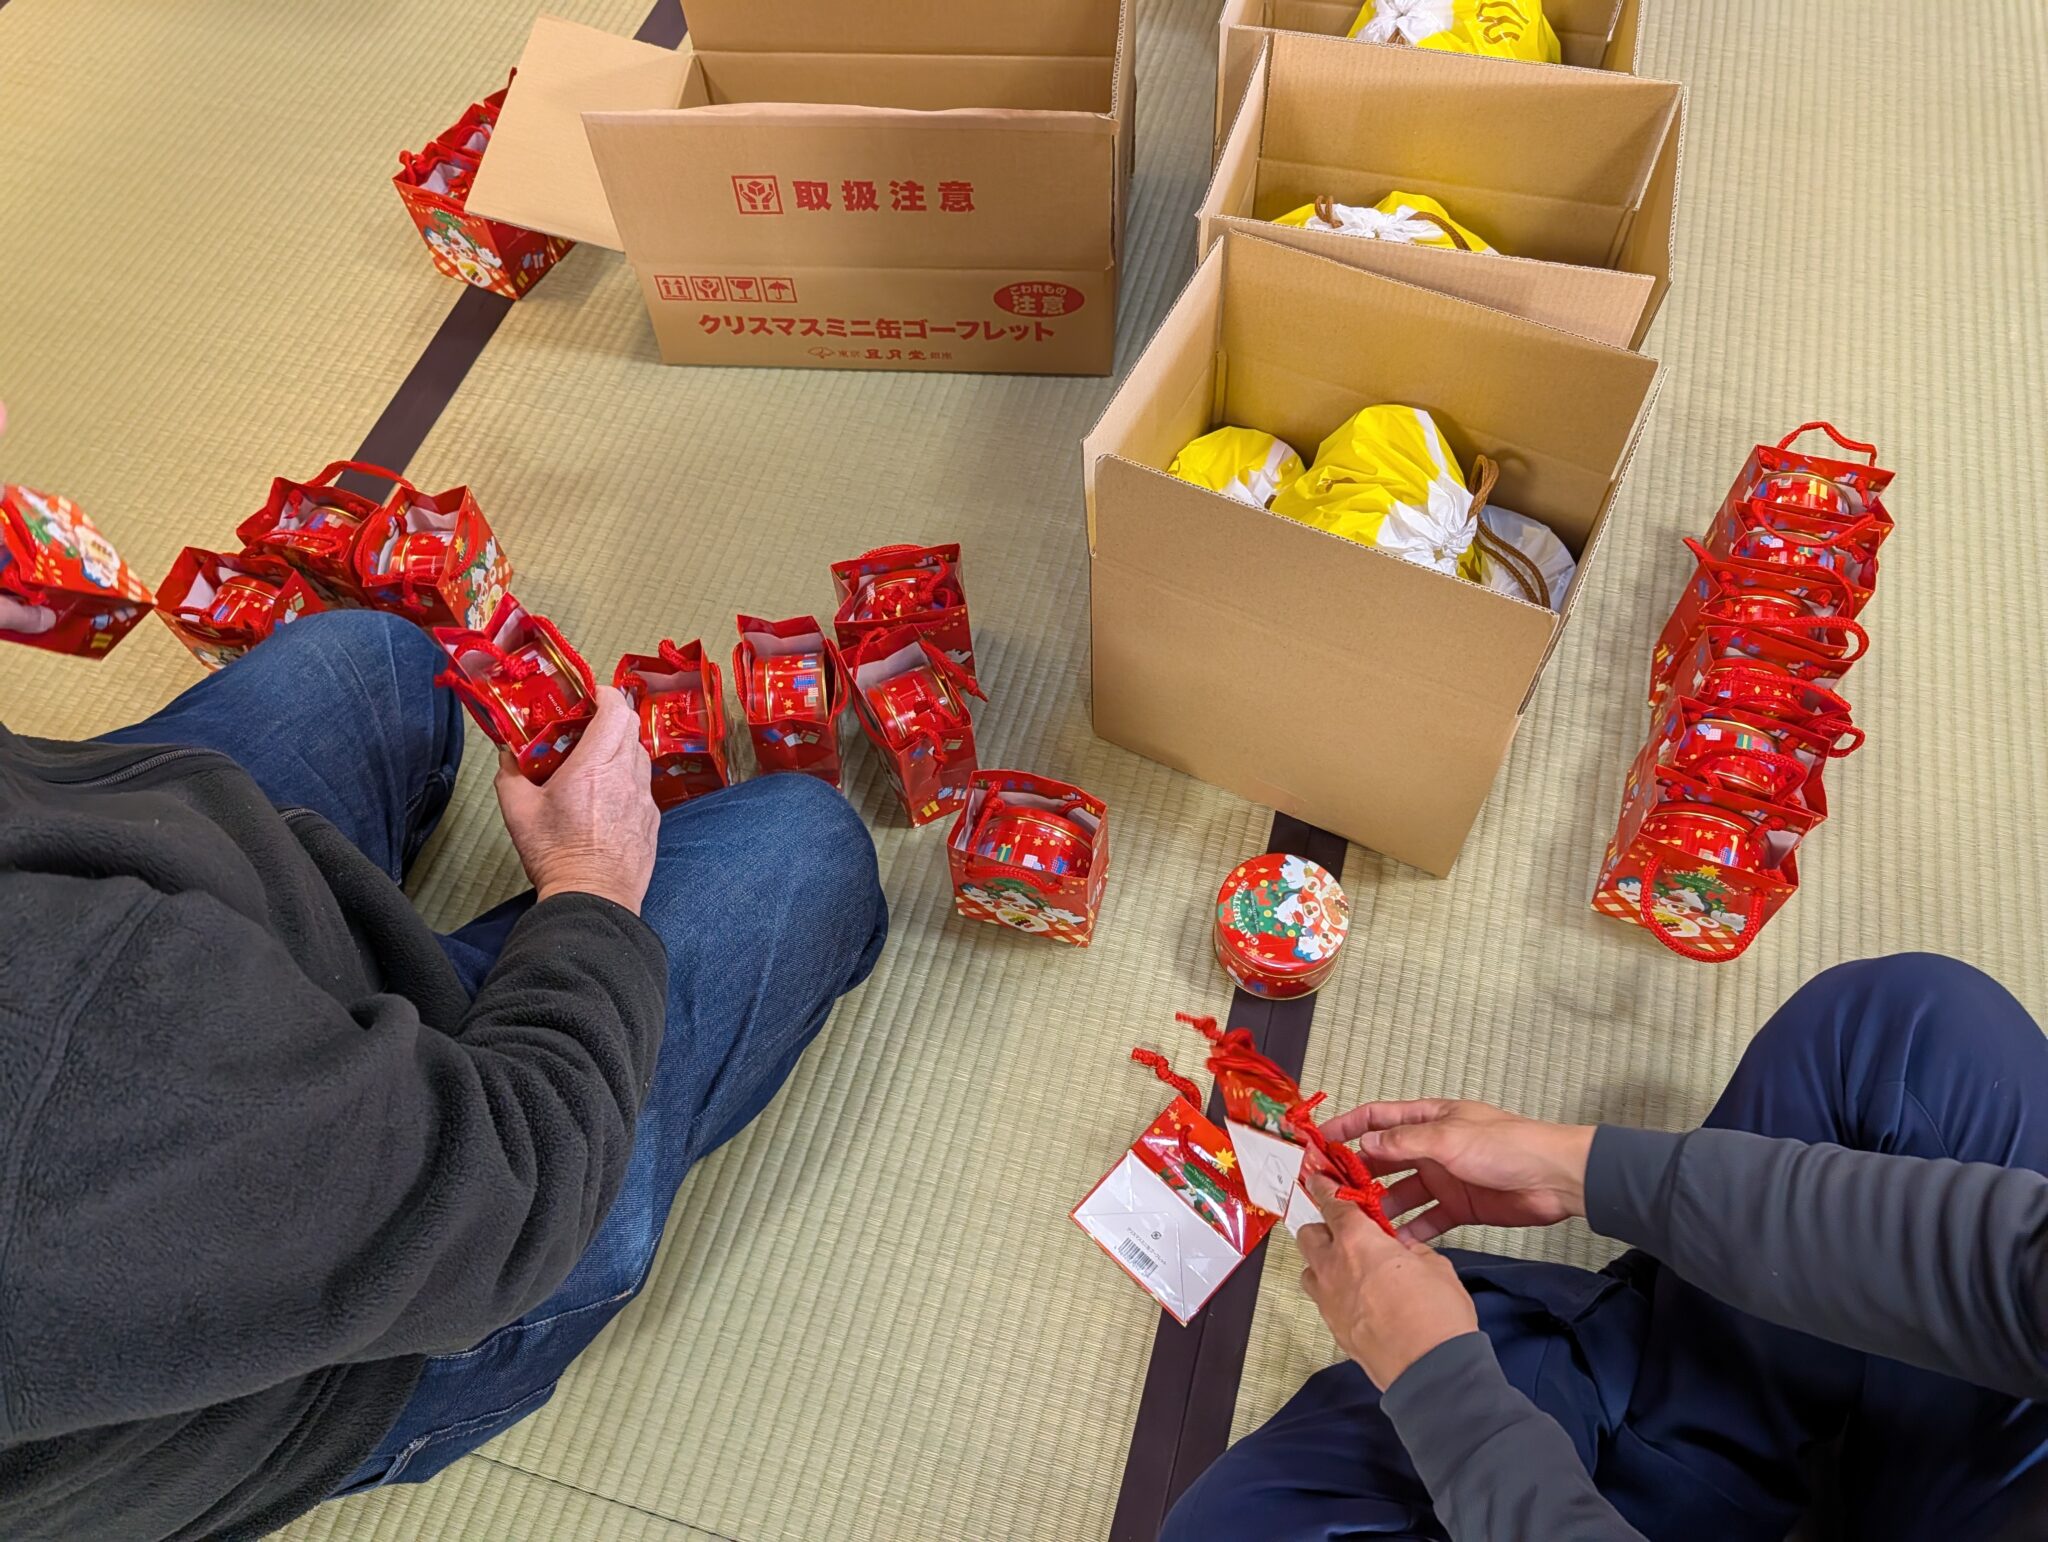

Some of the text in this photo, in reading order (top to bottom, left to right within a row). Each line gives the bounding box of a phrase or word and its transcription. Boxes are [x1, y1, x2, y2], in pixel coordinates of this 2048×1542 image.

[792, 180, 976, 213] 取扱注意
[1009, 284, 1068, 296] こわれもの
[1011, 295, 1065, 314] 注意
[698, 314, 1055, 342] クリスマスミニ缶ゴーフレット
[1232, 880, 1260, 946] GAUFRETTES
